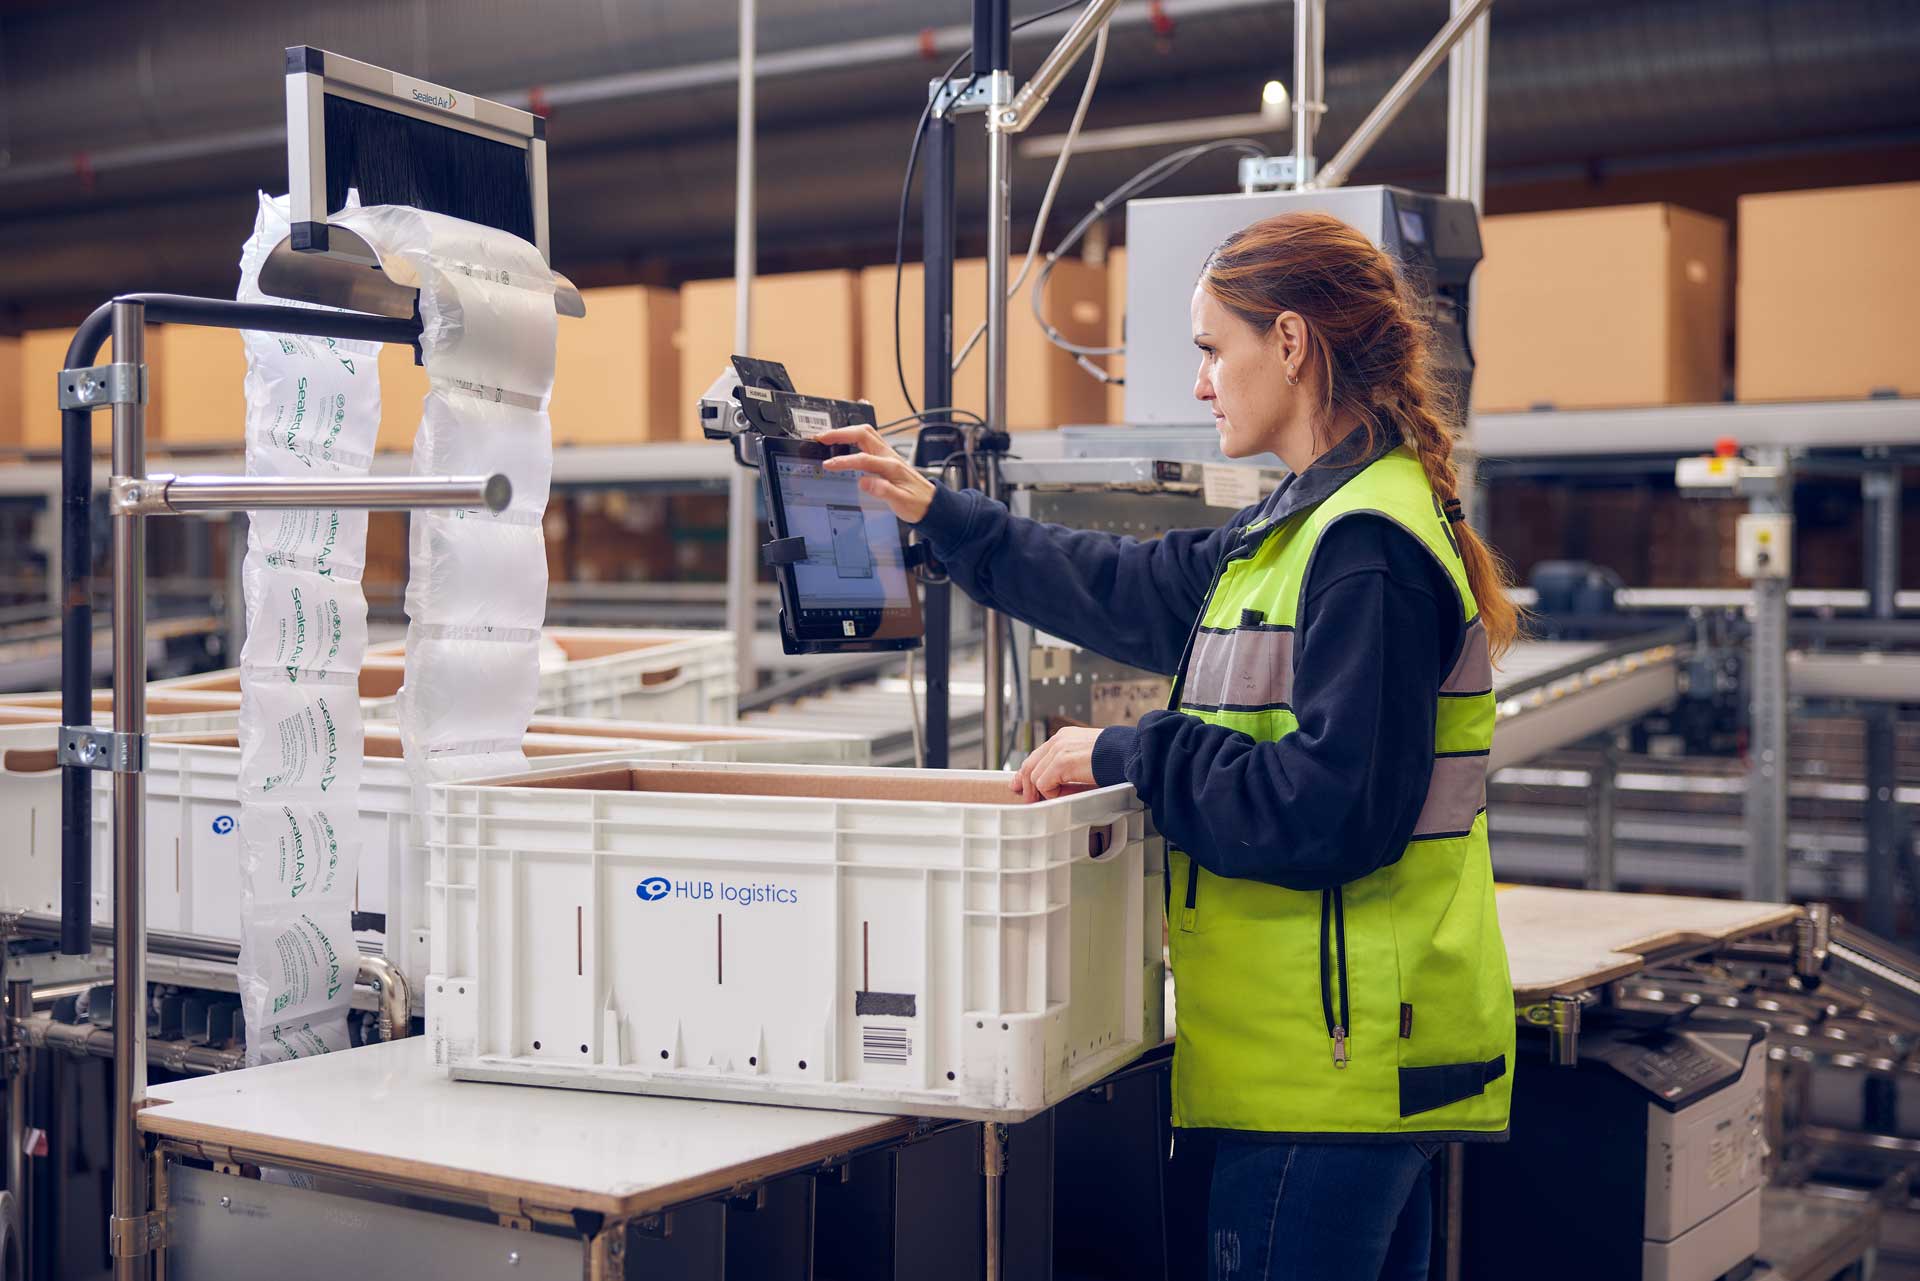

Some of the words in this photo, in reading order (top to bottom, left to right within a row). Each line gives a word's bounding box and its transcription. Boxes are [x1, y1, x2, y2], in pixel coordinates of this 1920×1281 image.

[412, 88, 437, 105] Sealed
[437, 96, 448, 108] Air
[291, 377, 308, 430] Sealed
[287, 431, 296, 452] Air
[318, 547, 332, 571] Air
[290, 587, 307, 644] Sealed
[289, 645, 304, 663] Air
[316, 698, 337, 754] Sealed
[325, 755, 338, 774] Air
[282, 806, 305, 860] Sealed
[295, 862, 305, 881] Air
[675, 880, 714, 900] HUB
[720, 882, 798, 906] logistics
[302, 914, 337, 962] Sealed
[330, 963, 340, 985] Air
